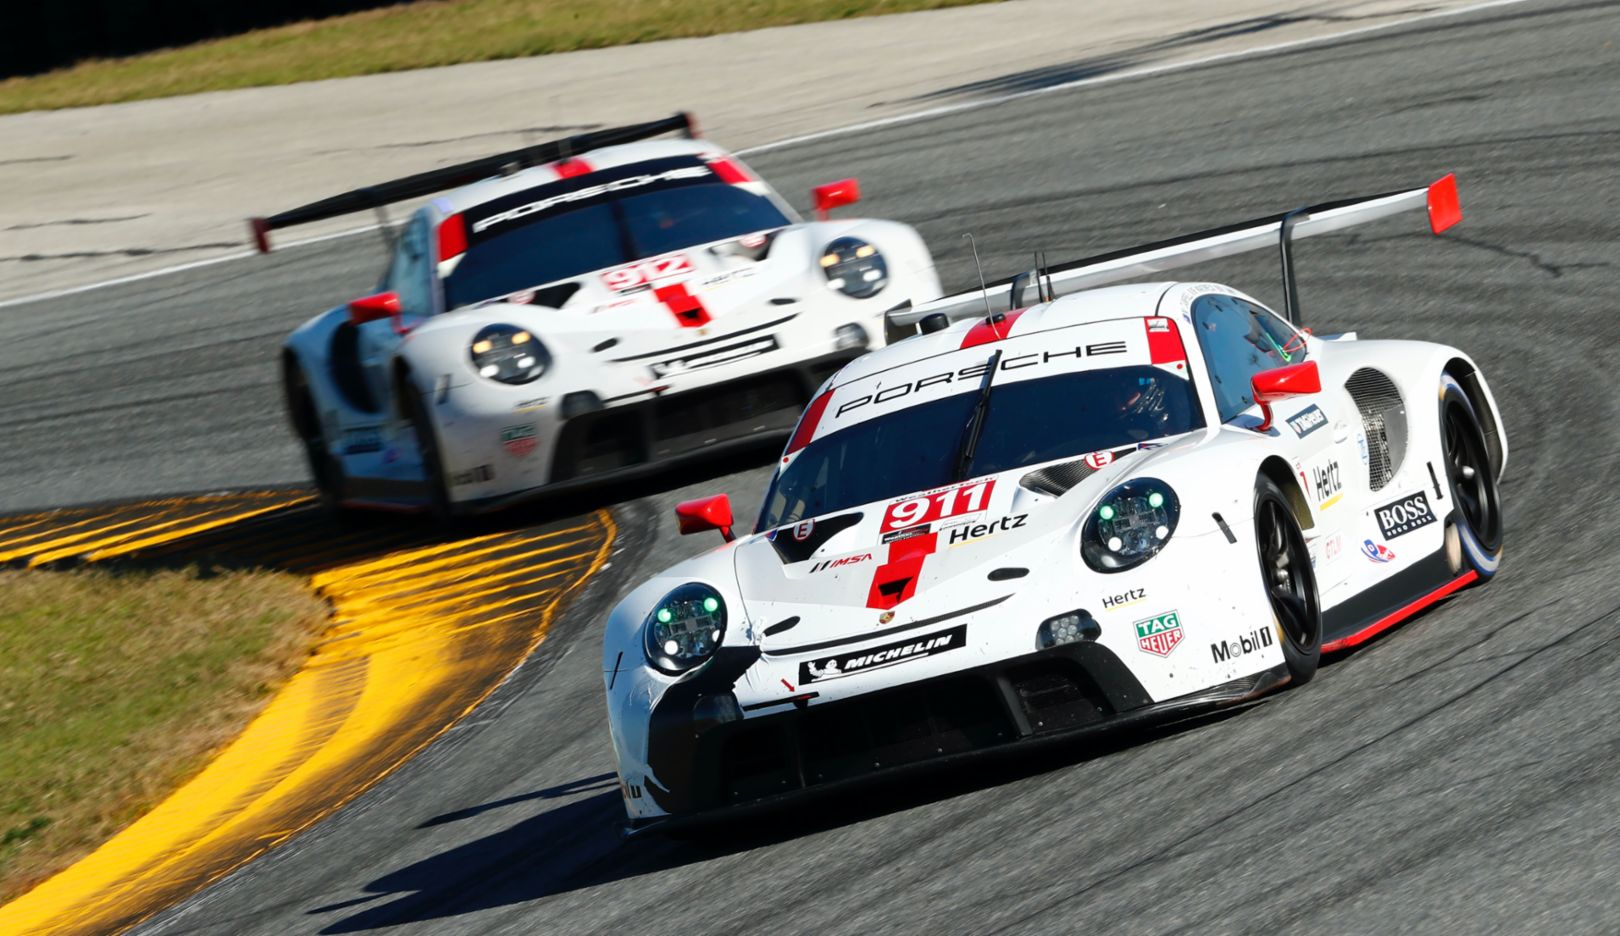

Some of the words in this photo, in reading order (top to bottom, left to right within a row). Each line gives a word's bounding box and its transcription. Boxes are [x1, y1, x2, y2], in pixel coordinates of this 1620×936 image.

[603, 254, 694, 291] 912
[834, 341, 1128, 419] PORSCHE
[1092, 452, 1106, 466] E
[1313, 458, 1342, 502] Hertz
[889, 482, 988, 529] 911
[1378, 496, 1428, 530] BOSS
[797, 522, 809, 538] E
[949, 513, 1029, 545] Hertz
[829, 553, 873, 569] IMSA
[1102, 587, 1147, 609] Hertz
[1137, 614, 1178, 636] TAG
[843, 634, 953, 670] MICHELIN
[1139, 628, 1184, 656] HEUER
[1210, 630, 1261, 664] Mobil
[1260, 626, 1273, 648] 1
